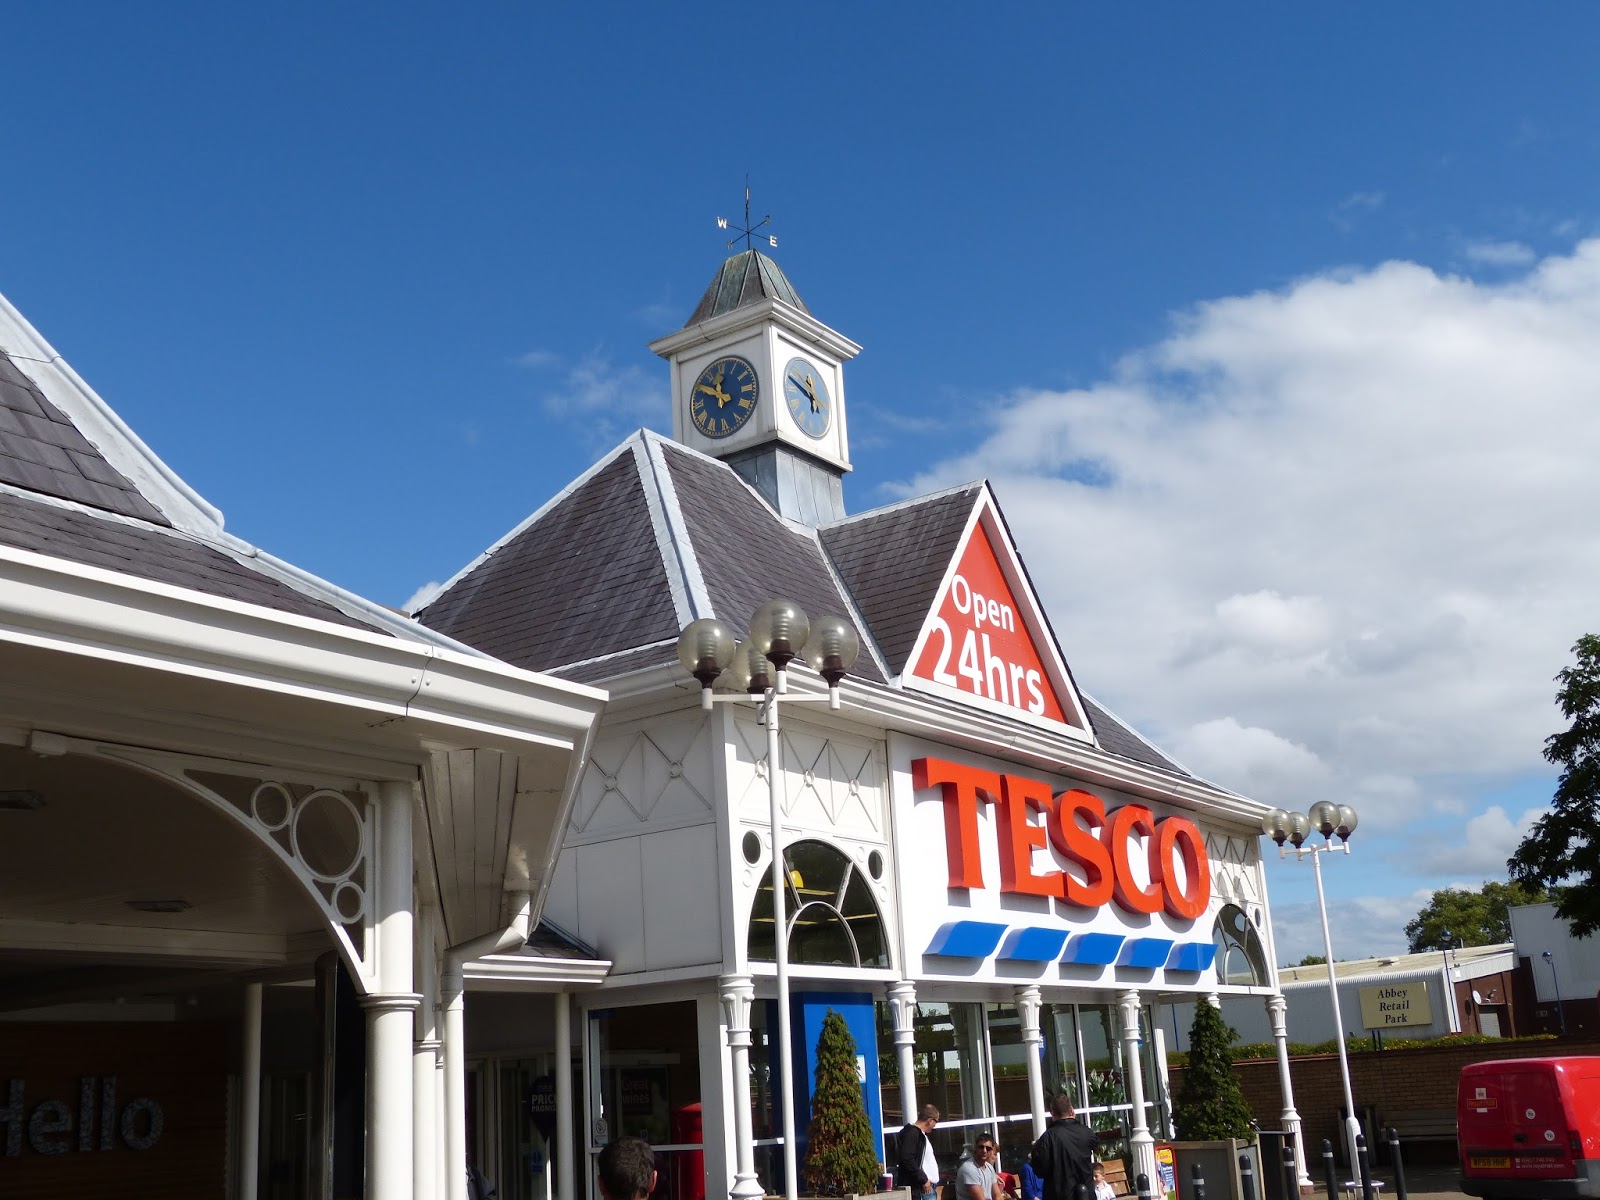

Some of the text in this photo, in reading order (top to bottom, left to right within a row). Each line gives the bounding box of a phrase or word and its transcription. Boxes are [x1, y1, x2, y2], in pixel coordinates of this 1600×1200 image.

[769, 233, 778, 247] E
[951, 573, 1015, 633] Open
[930, 615, 1045, 715] 24hrs
[911, 756, 1211, 920] TESCO
[1377, 988, 1408, 999] Abbey
[1379, 1000, 1410, 1011] Retail
[1385, 1013, 1408, 1024] Park
[531, 1104, 556, 1113] PROMIS
[0, 1075, 164, 1157] Hello
